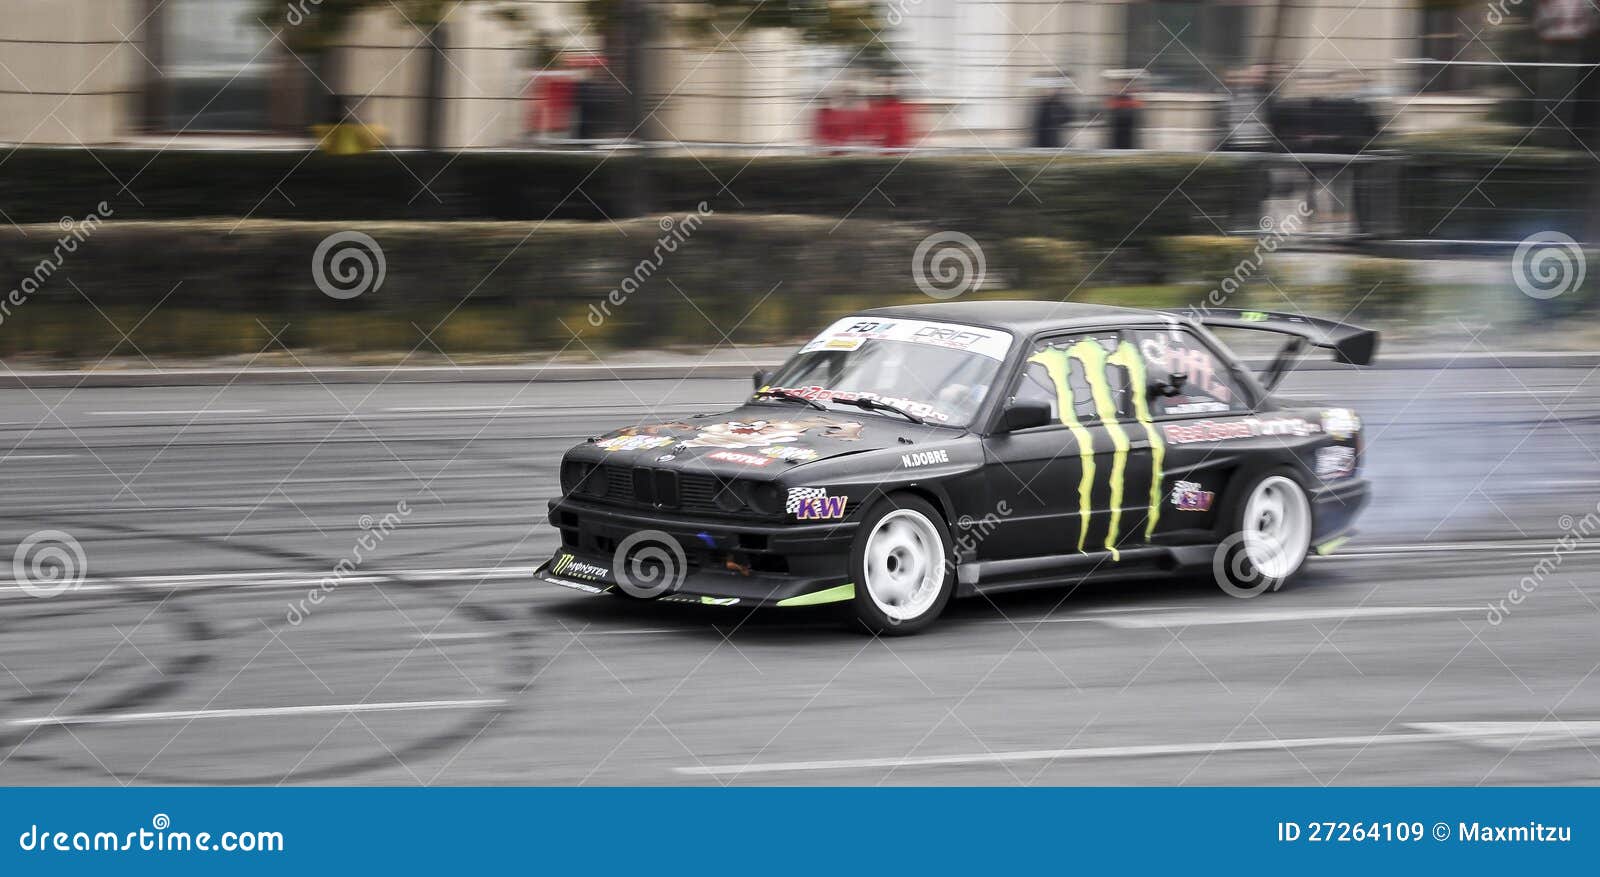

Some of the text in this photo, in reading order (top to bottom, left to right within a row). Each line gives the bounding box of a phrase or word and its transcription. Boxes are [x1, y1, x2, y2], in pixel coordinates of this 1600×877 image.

[913, 326, 992, 344] DRIFT
[901, 449, 949, 468] N.DOBRE
[797, 496, 849, 520] KW
